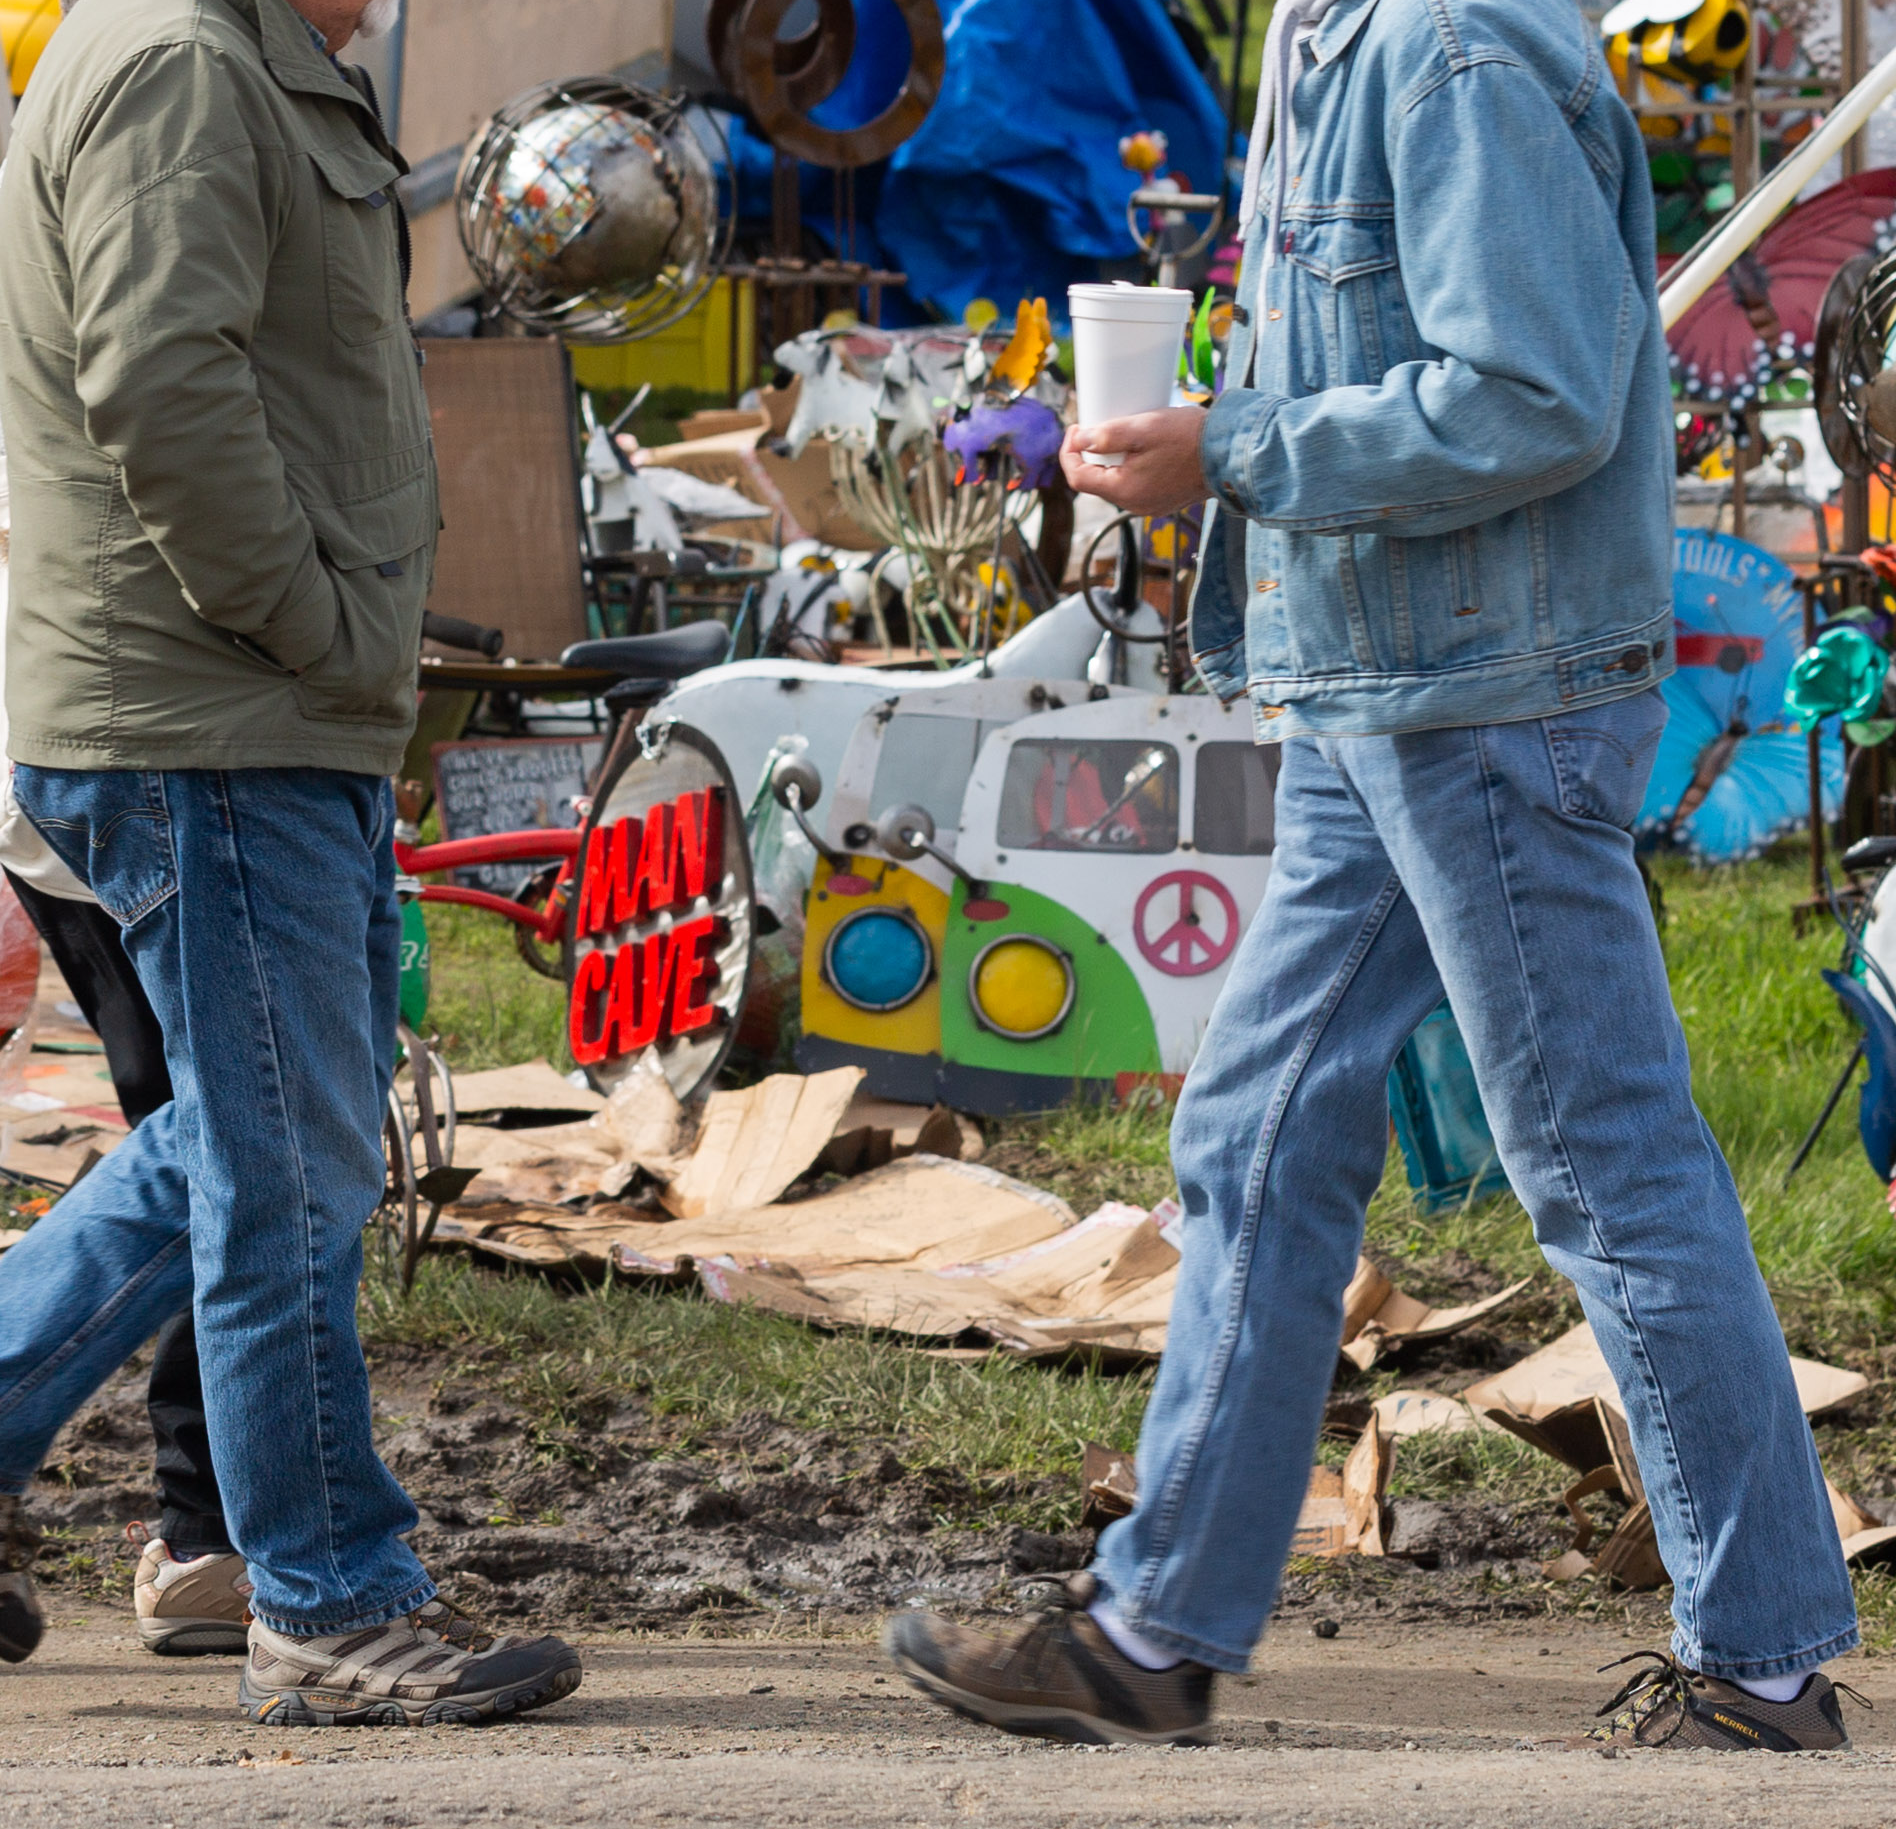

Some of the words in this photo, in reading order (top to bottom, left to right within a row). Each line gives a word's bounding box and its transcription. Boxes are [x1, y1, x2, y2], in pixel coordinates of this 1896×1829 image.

[575, 785, 723, 940] MAN
[569, 914, 726, 1066] CAVE
[1712, 1711, 1761, 1741] MERRELL
